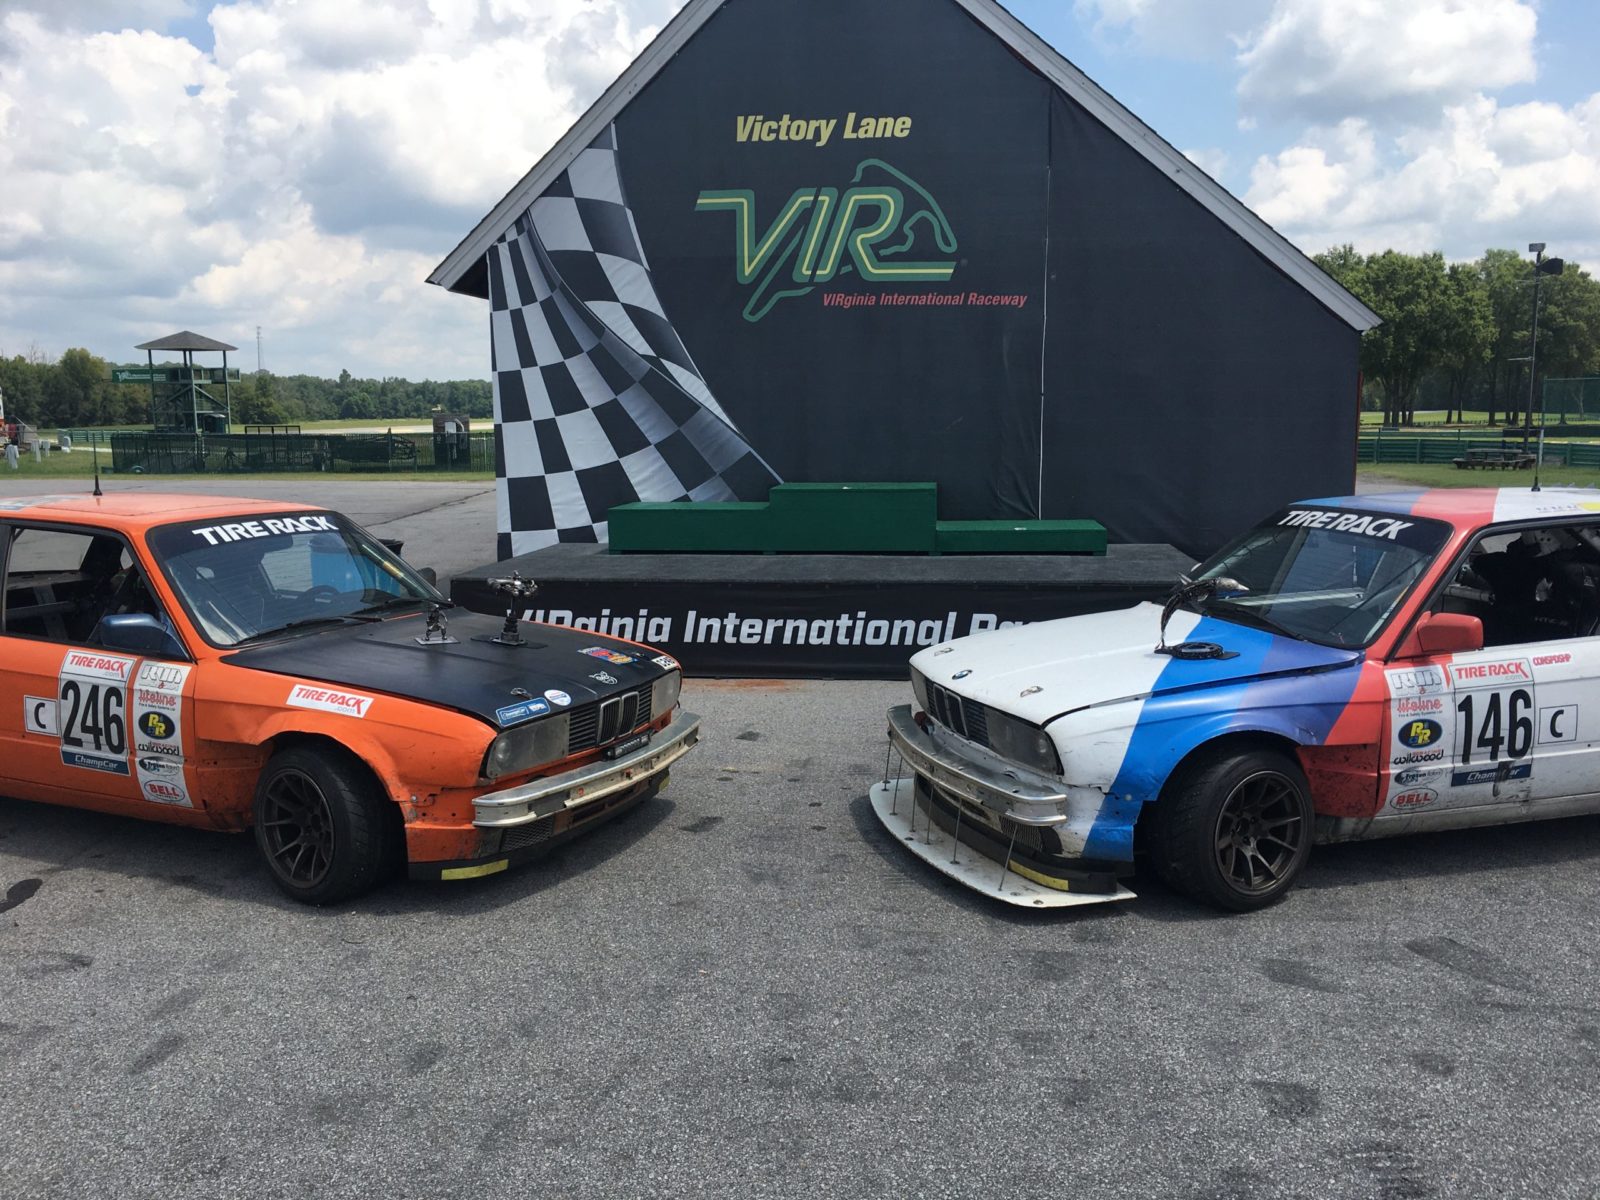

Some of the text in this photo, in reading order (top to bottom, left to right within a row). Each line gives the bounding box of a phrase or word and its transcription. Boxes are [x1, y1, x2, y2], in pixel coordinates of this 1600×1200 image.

[736, 112, 912, 147] Victory Lane
[695, 186, 957, 285] VIR
[823, 292, 1027, 308] VIRginia International Raceway
[192, 515, 339, 545] TIRE RACK
[1277, 510, 1414, 540] TIRE RACK
[684, 610, 957, 646] International
[70, 654, 127, 678] TIRE RACK
[1455, 662, 1529, 680] TIRE RACK
[295, 687, 365, 715] TIRE RACK
[34, 702, 47, 729] C
[61, 680, 125, 755] 246
[1457, 688, 1532, 765] 146
[1550, 709, 1564, 739] C
[75, 754, 119, 769] ChampCar
[1393, 749, 1444, 765] wilwood
[1467, 768, 1521, 781] Chamar
[149, 783, 180, 797] BELL
[1396, 792, 1431, 805] BELL
